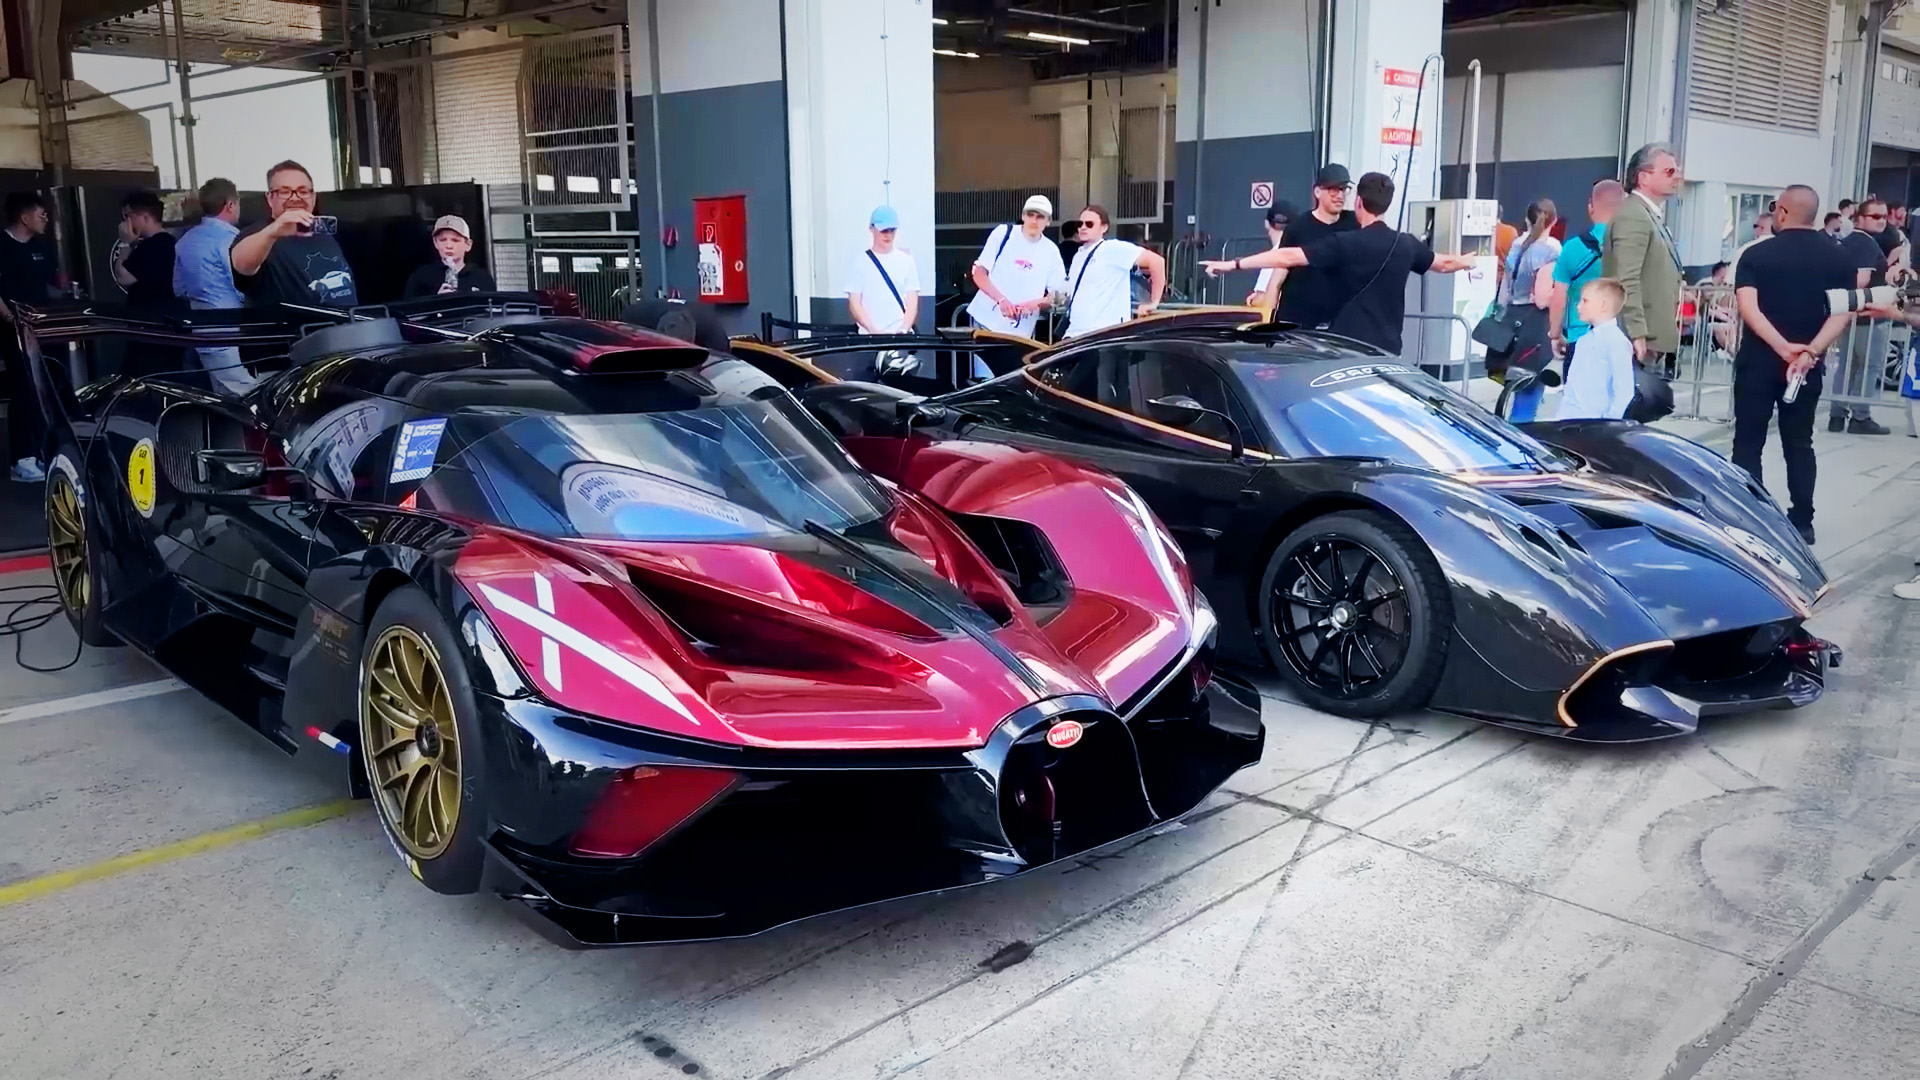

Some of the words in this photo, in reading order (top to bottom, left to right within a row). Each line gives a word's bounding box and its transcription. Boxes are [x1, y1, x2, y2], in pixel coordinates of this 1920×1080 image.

[1388, 131, 1414, 142] ACHTUN
[140, 468, 144, 485] 1
[1052, 727, 1080, 742] BUGATTI
